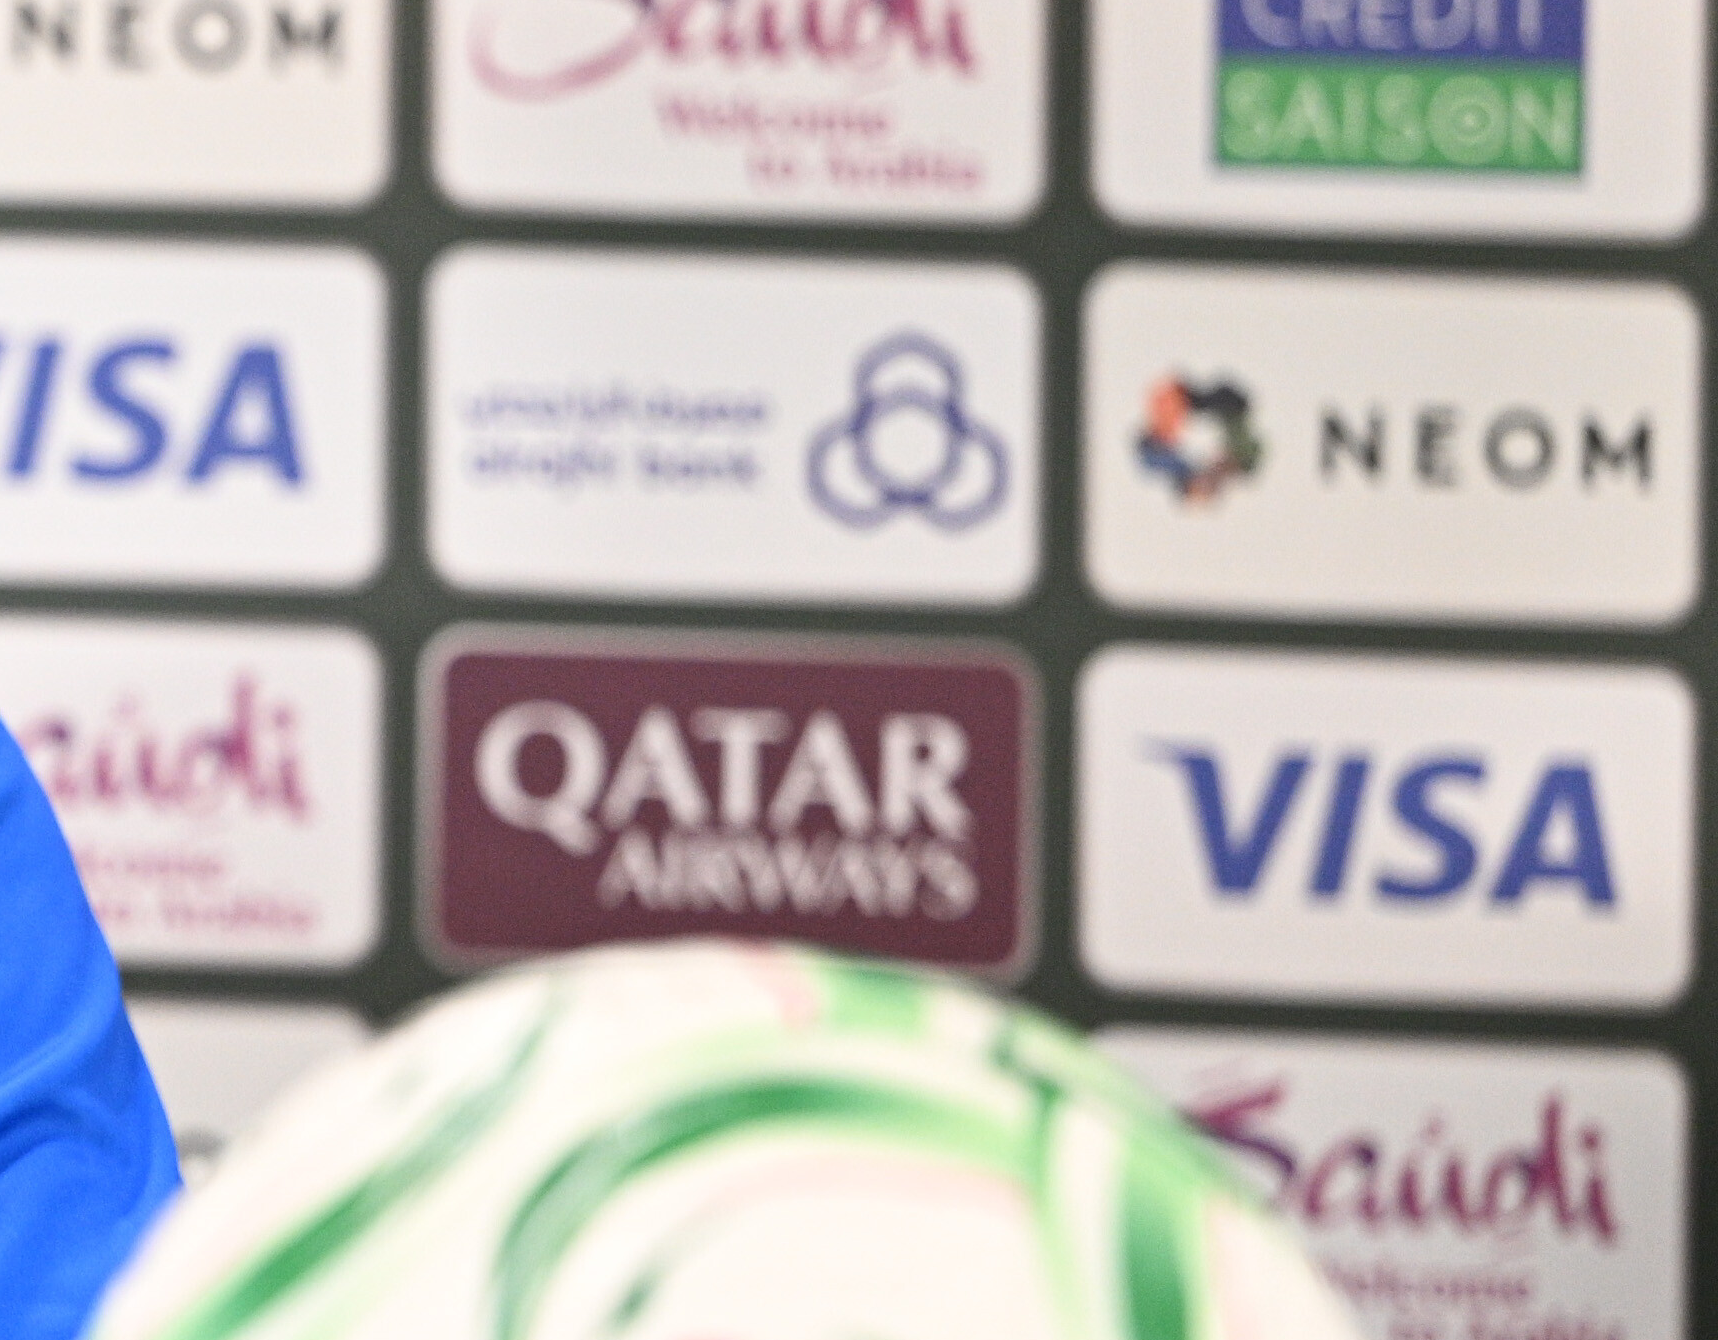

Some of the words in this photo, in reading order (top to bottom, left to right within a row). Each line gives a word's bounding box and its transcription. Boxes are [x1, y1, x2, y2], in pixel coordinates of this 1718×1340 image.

[1220, 64, 1578, 163] SAISON
[1317, 406, 1657, 490] NEOM
[475, 702, 972, 854] QATAR
[596, 834, 979, 917] AIRWAYS
[1168, 747, 1622, 915] VISA
